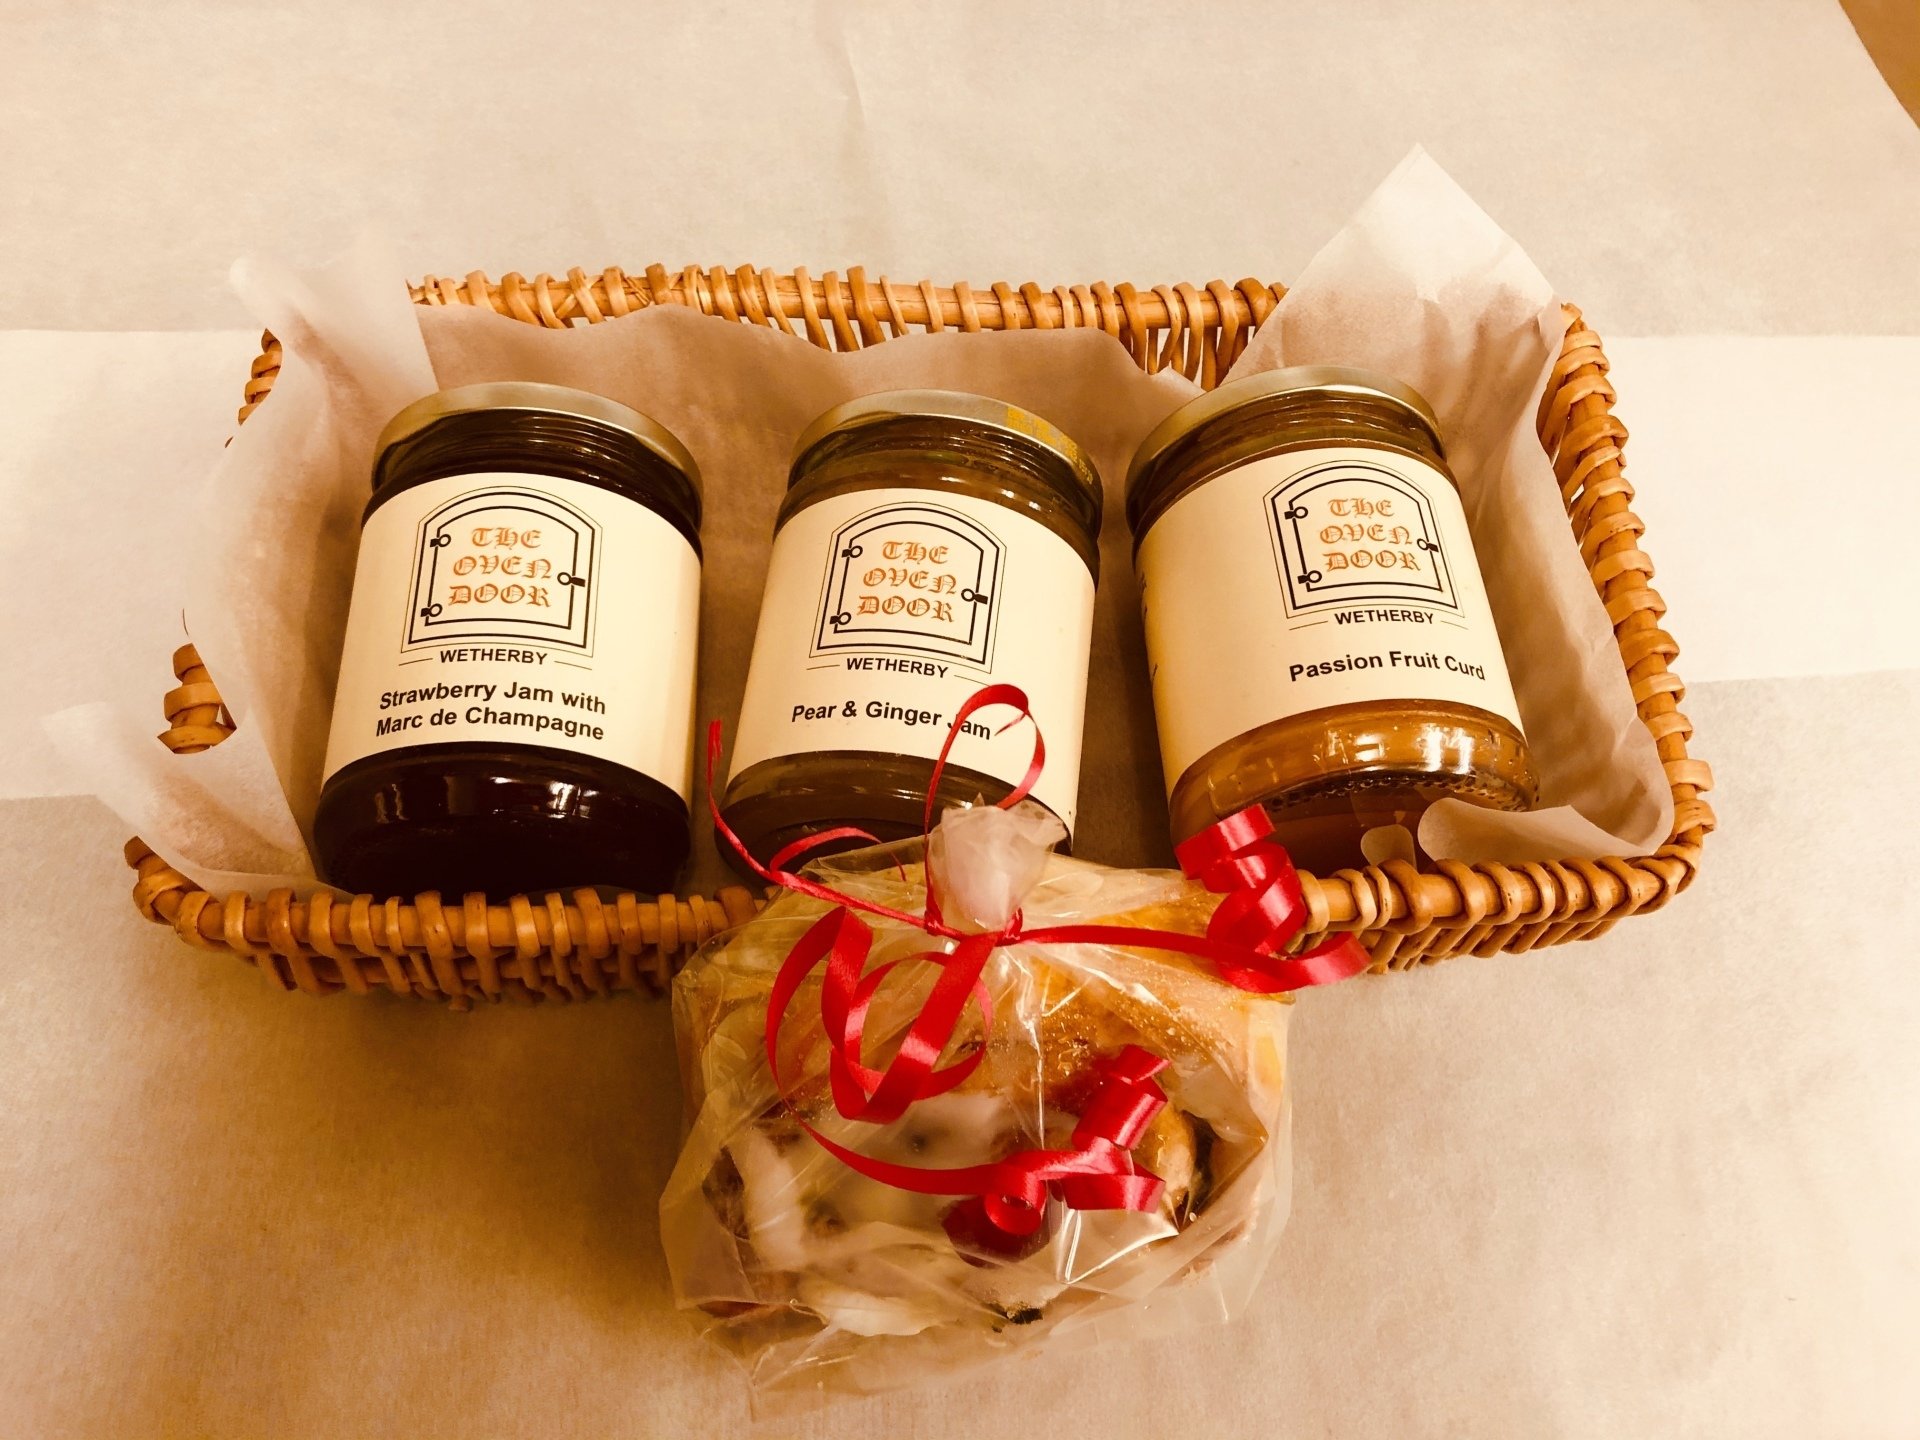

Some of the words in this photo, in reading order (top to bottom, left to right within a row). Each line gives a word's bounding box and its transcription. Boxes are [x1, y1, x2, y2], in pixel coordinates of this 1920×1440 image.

[1328, 498, 1394, 519] THE
[471, 527, 541, 549] THE
[1319, 524, 1413, 545] OVEN
[882, 541, 949, 565] THE
[1323, 550, 1422, 572] DOOR
[453, 555, 552, 579] OVEN
[862, 568, 958, 595] OVEN
[447, 584, 552, 607] DOOR
[856, 596, 955, 623] DOOR
[1334, 609, 1434, 626] WETHERBY
[439, 648, 548, 665] WETHERBY
[846, 657, 949, 679] WETHERBY
[1289, 654, 1383, 682] Passion
[1388, 651, 1440, 670] Fruit
[1445, 656, 1486, 681] Curd
[379, 683, 497, 710] Strawberry
[504, 682, 553, 702] Jam
[561, 692, 606, 715] with
[376, 716, 422, 737] Marc
[430, 708, 457, 725] de
[465, 706, 605, 740] Champagne
[791, 705, 837, 723] Pear
[842, 701, 857, 717] &
[865, 701, 942, 726] Ginger
